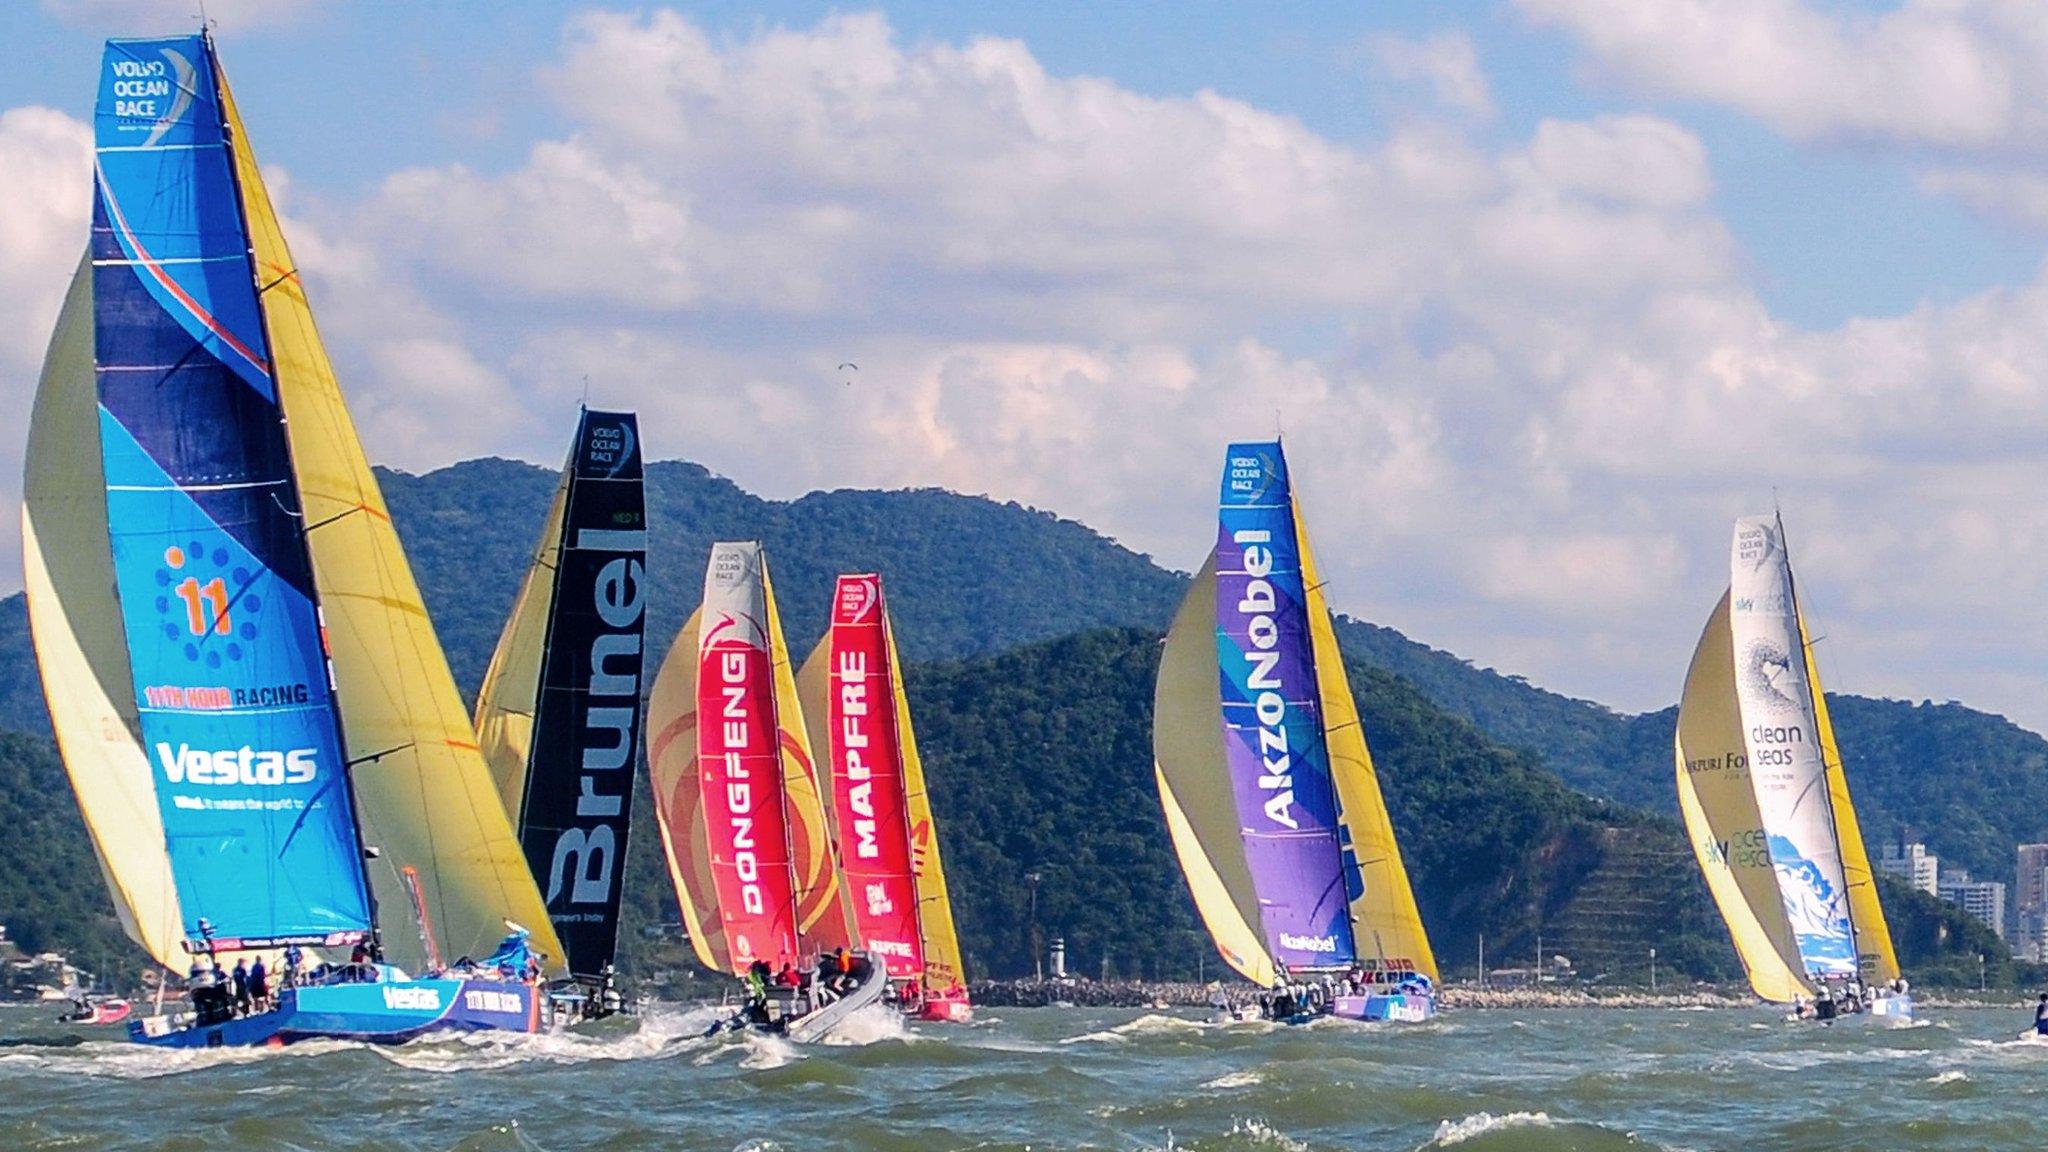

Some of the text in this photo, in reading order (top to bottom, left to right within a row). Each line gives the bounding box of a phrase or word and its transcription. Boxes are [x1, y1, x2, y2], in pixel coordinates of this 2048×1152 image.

[111, 61, 165, 77] VOLVO
[113, 81, 168, 97] OCEAN
[115, 101, 156, 116] RACE
[591, 440, 620, 450] OCEAN
[175, 577, 231, 635] 11
[1233, 529, 1299, 830] AkzoNobel
[235, 683, 308, 706] RACING
[547, 528, 648, 904] Brunel
[1753, 724, 1802, 744] clean
[156, 742, 318, 786] Vestas
[840, 651, 879, 858] MAPFRE
[1758, 748, 1793, 766] seas
[722, 652, 764, 915] DONGFENG
[383, 986, 441, 1010] Vestas
